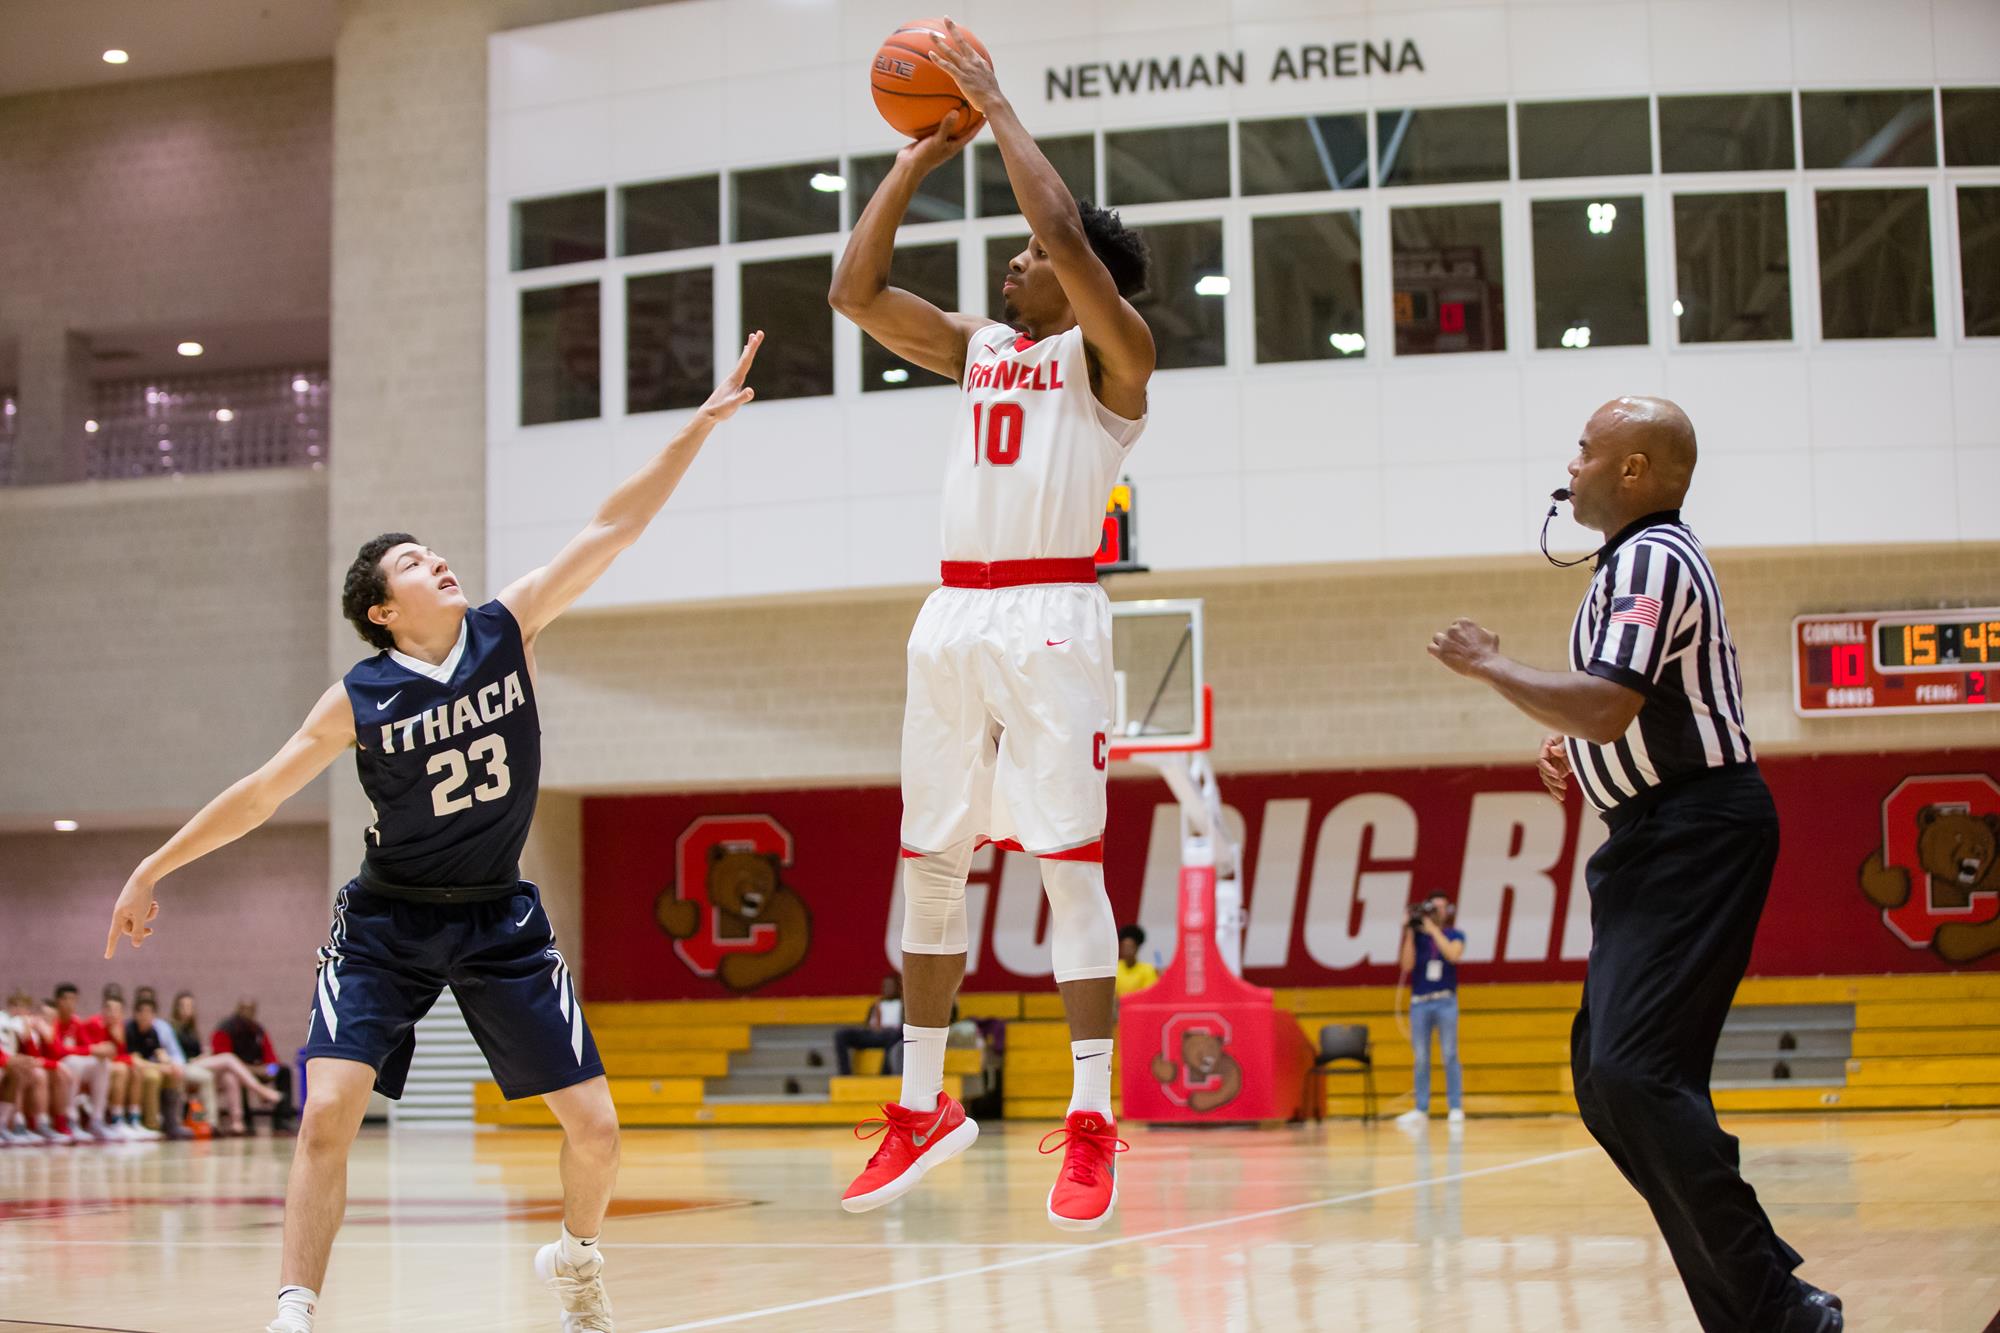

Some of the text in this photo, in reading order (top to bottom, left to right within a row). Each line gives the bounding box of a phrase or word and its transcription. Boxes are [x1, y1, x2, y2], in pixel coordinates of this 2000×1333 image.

[875, 55, 916, 80] ELITE
[1045, 39, 1424, 101] NEWMAN ARENA
[967, 359, 1064, 393] ORNELL
[972, 400, 1026, 468] 10
[1802, 621, 1867, 646] CORNELL
[1831, 643, 1866, 687] 10
[1826, 686, 1875, 708] BONUS
[1966, 671, 1985, 705] 2
[380, 670, 526, 754] ITHACA
[1092, 730, 1106, 772] C
[425, 732, 511, 817] 23
